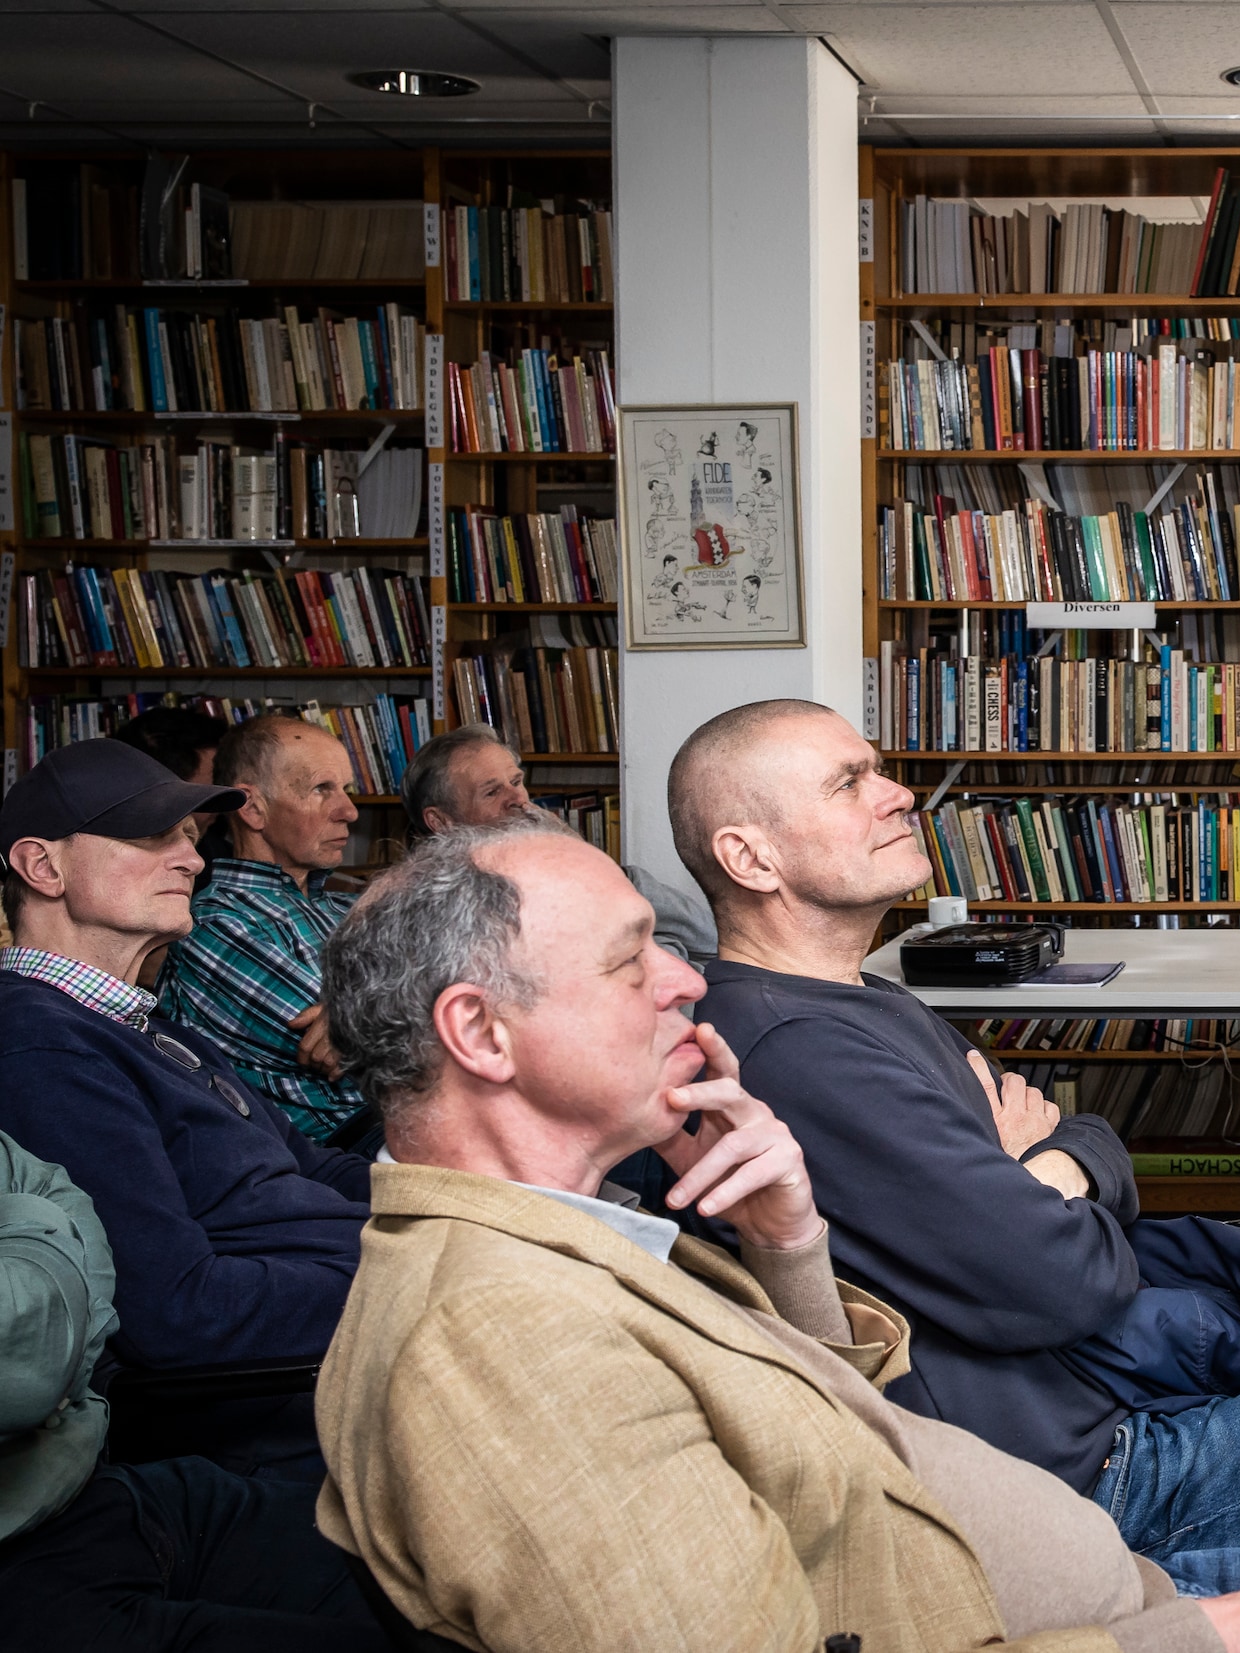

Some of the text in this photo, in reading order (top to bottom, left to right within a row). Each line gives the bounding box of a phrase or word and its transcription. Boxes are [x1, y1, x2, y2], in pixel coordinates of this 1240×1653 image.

[427, 210, 438, 261] EUWE
[861, 206, 871, 257] KNSB
[428, 335, 440, 445] MIDDLEGAME
[866, 324, 874, 435] NEDERLANDS
[703, 462, 733, 485] FIDE
[434, 465, 442, 576] TOURNAMENTS
[692, 570, 737, 580] AMSTERDAM
[1064, 601, 1121, 614] Diversen
[436, 607, 444, 718] TOURNAMENTS
[867, 661, 875, 737] VARIOUS
[987, 692, 999, 721] CHESS
[1018, 678, 1027, 708] Schach
[1026, 827, 1039, 860] CHESS
